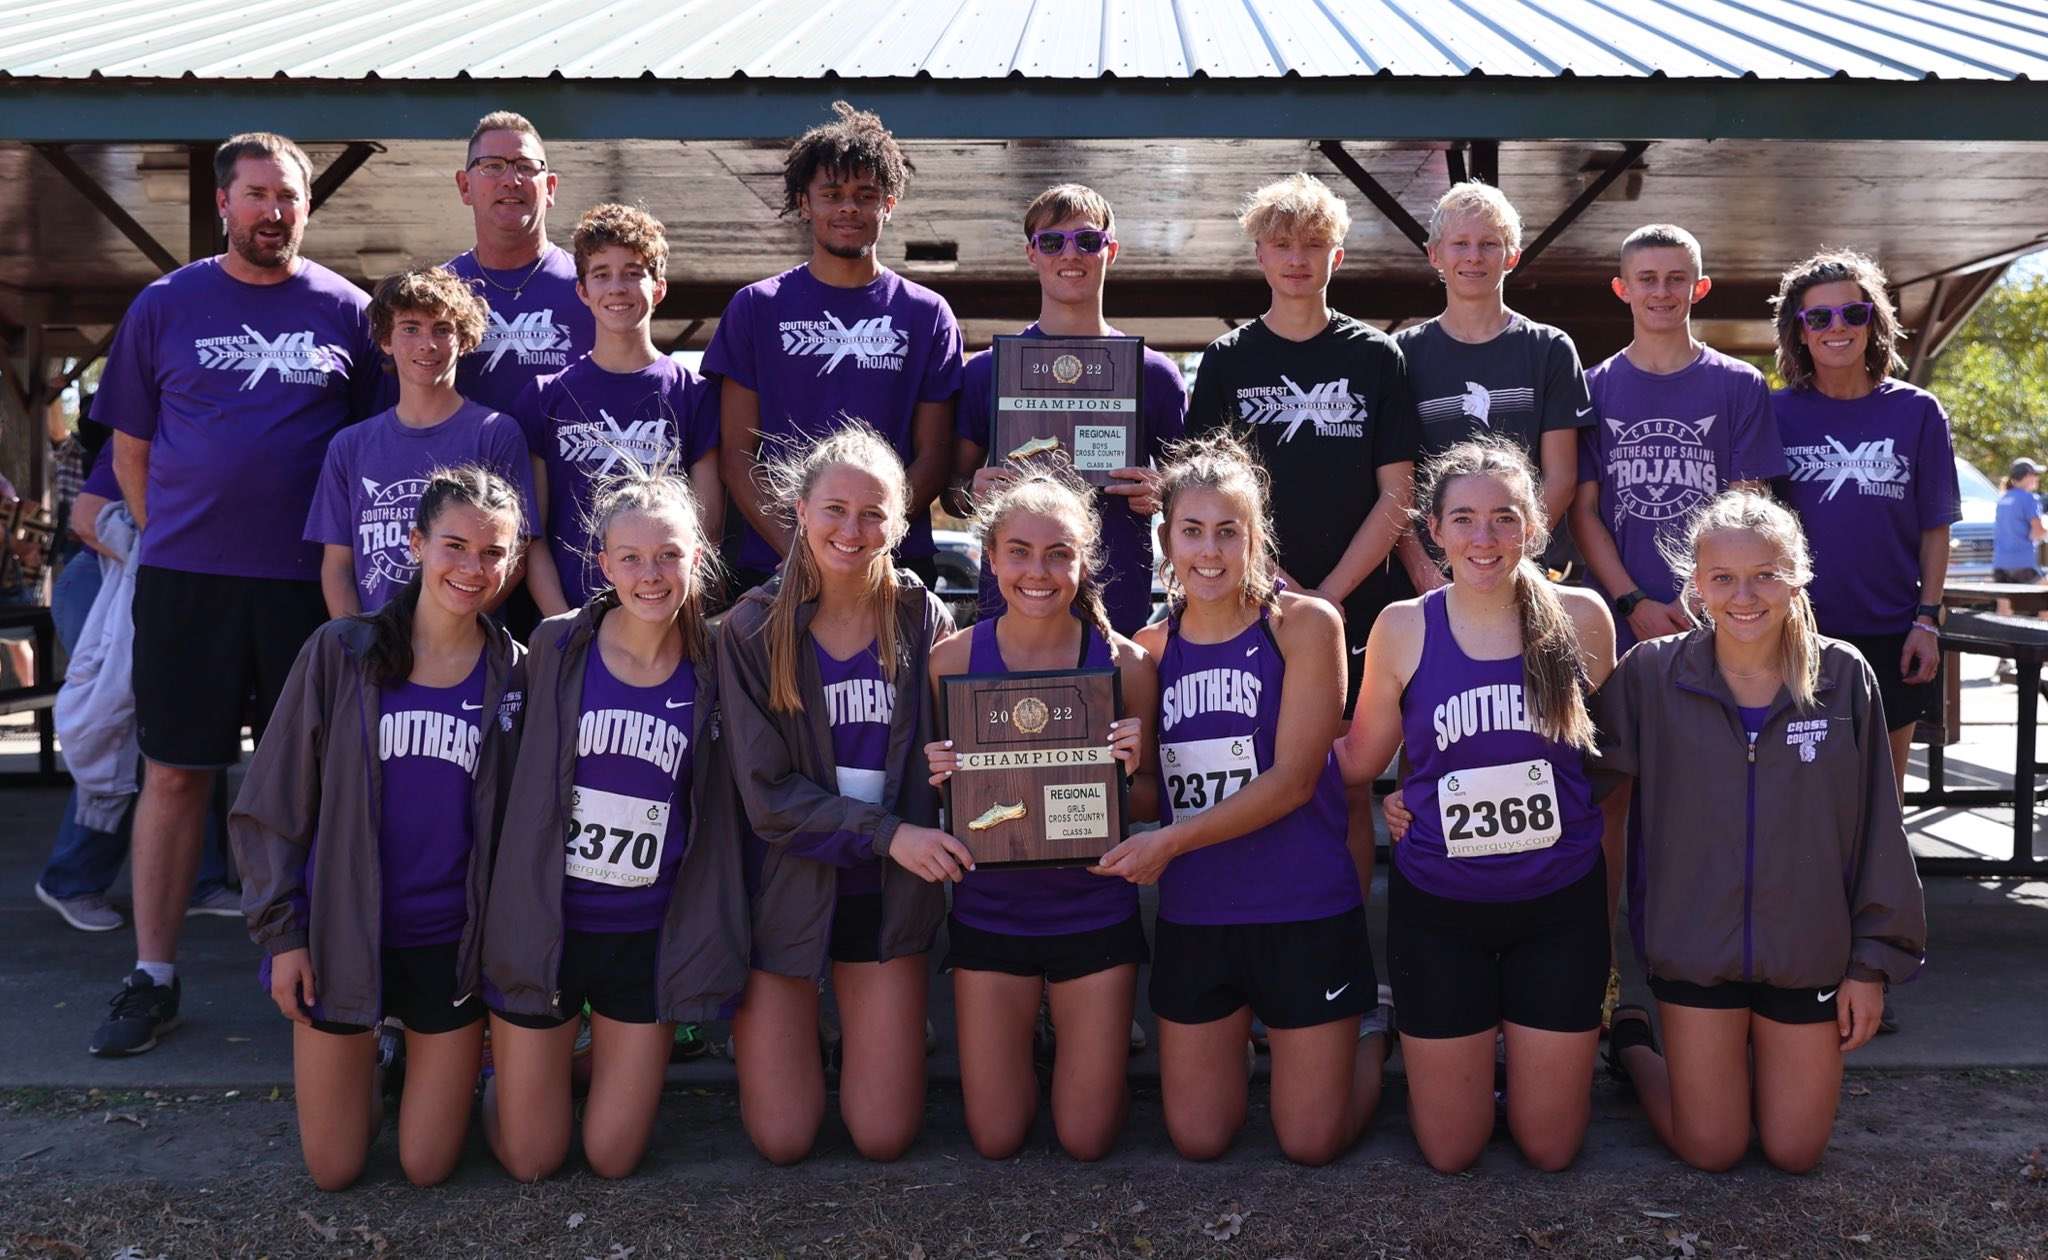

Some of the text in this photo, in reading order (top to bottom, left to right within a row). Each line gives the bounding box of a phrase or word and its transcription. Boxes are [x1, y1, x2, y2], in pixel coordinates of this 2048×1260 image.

[779, 320, 831, 332] SOUTHEAST
[195, 335, 250, 348] SOUTHEAST
[800, 336, 895, 345] CROSS COUNTRY
[218, 351, 258, 360] CROSS
[516, 350, 568, 367] TROJANS
[855, 356, 904, 371] TROJANS
[1033, 363, 1102, 375] 20 22
[278, 369, 330, 387] TROJANS
[1236, 386, 1288, 399] SOUTHEAST
[1014, 399, 1122, 410] CHAMPIONS
[1259, 401, 1351, 411] CROSS COUNTRY
[557, 421, 605, 437] SOUTHEAST
[1079, 429, 1121, 439] REGIONAL
[1314, 423, 1364, 438] TROJANS
[1631, 422, 1686, 439] CROSS
[1075, 449, 1125, 457] CROSS COUNTRY
[1092, 442, 1108, 450] BOYS
[1664, 445, 1677, 458] OF
[1801, 460, 1897, 471] CROSS COUNTRY
[1606, 459, 1717, 496] TROJANS
[386, 482, 430, 501] CROS
[1856, 480, 1905, 500] TROJANS
[1623, 490, 1695, 517] COUNTRY
[361, 507, 416, 523] SOUTHEAST
[359, 521, 417, 556] TROJ
[823, 678, 896, 728] UTHEAS
[1163, 668, 1263, 732] SOUTHEAST
[989, 707, 1073, 724] 20 22
[1787, 719, 1828, 733] CROSS
[576, 708, 689, 781] OUTHEAST
[1786, 730, 1828, 745] COUNTRY
[379, 710, 483, 781] OUTHEAS
[969, 750, 1098, 767] CHAMPIONS
[1050, 787, 1101, 800] REGIONAL
[1167, 768, 1252, 810] 2377
[1066, 804, 1086, 813] GIRLS
[1048, 812, 1105, 823] CROSS COUNTRY
[1446, 793, 1555, 841] 2368
[1062, 828, 1093, 836] CLASS 3A
[565, 818, 658, 870] 2370
[1452, 835, 1556, 855] timerguys.com
[568, 862, 650, 884] erguys.com
